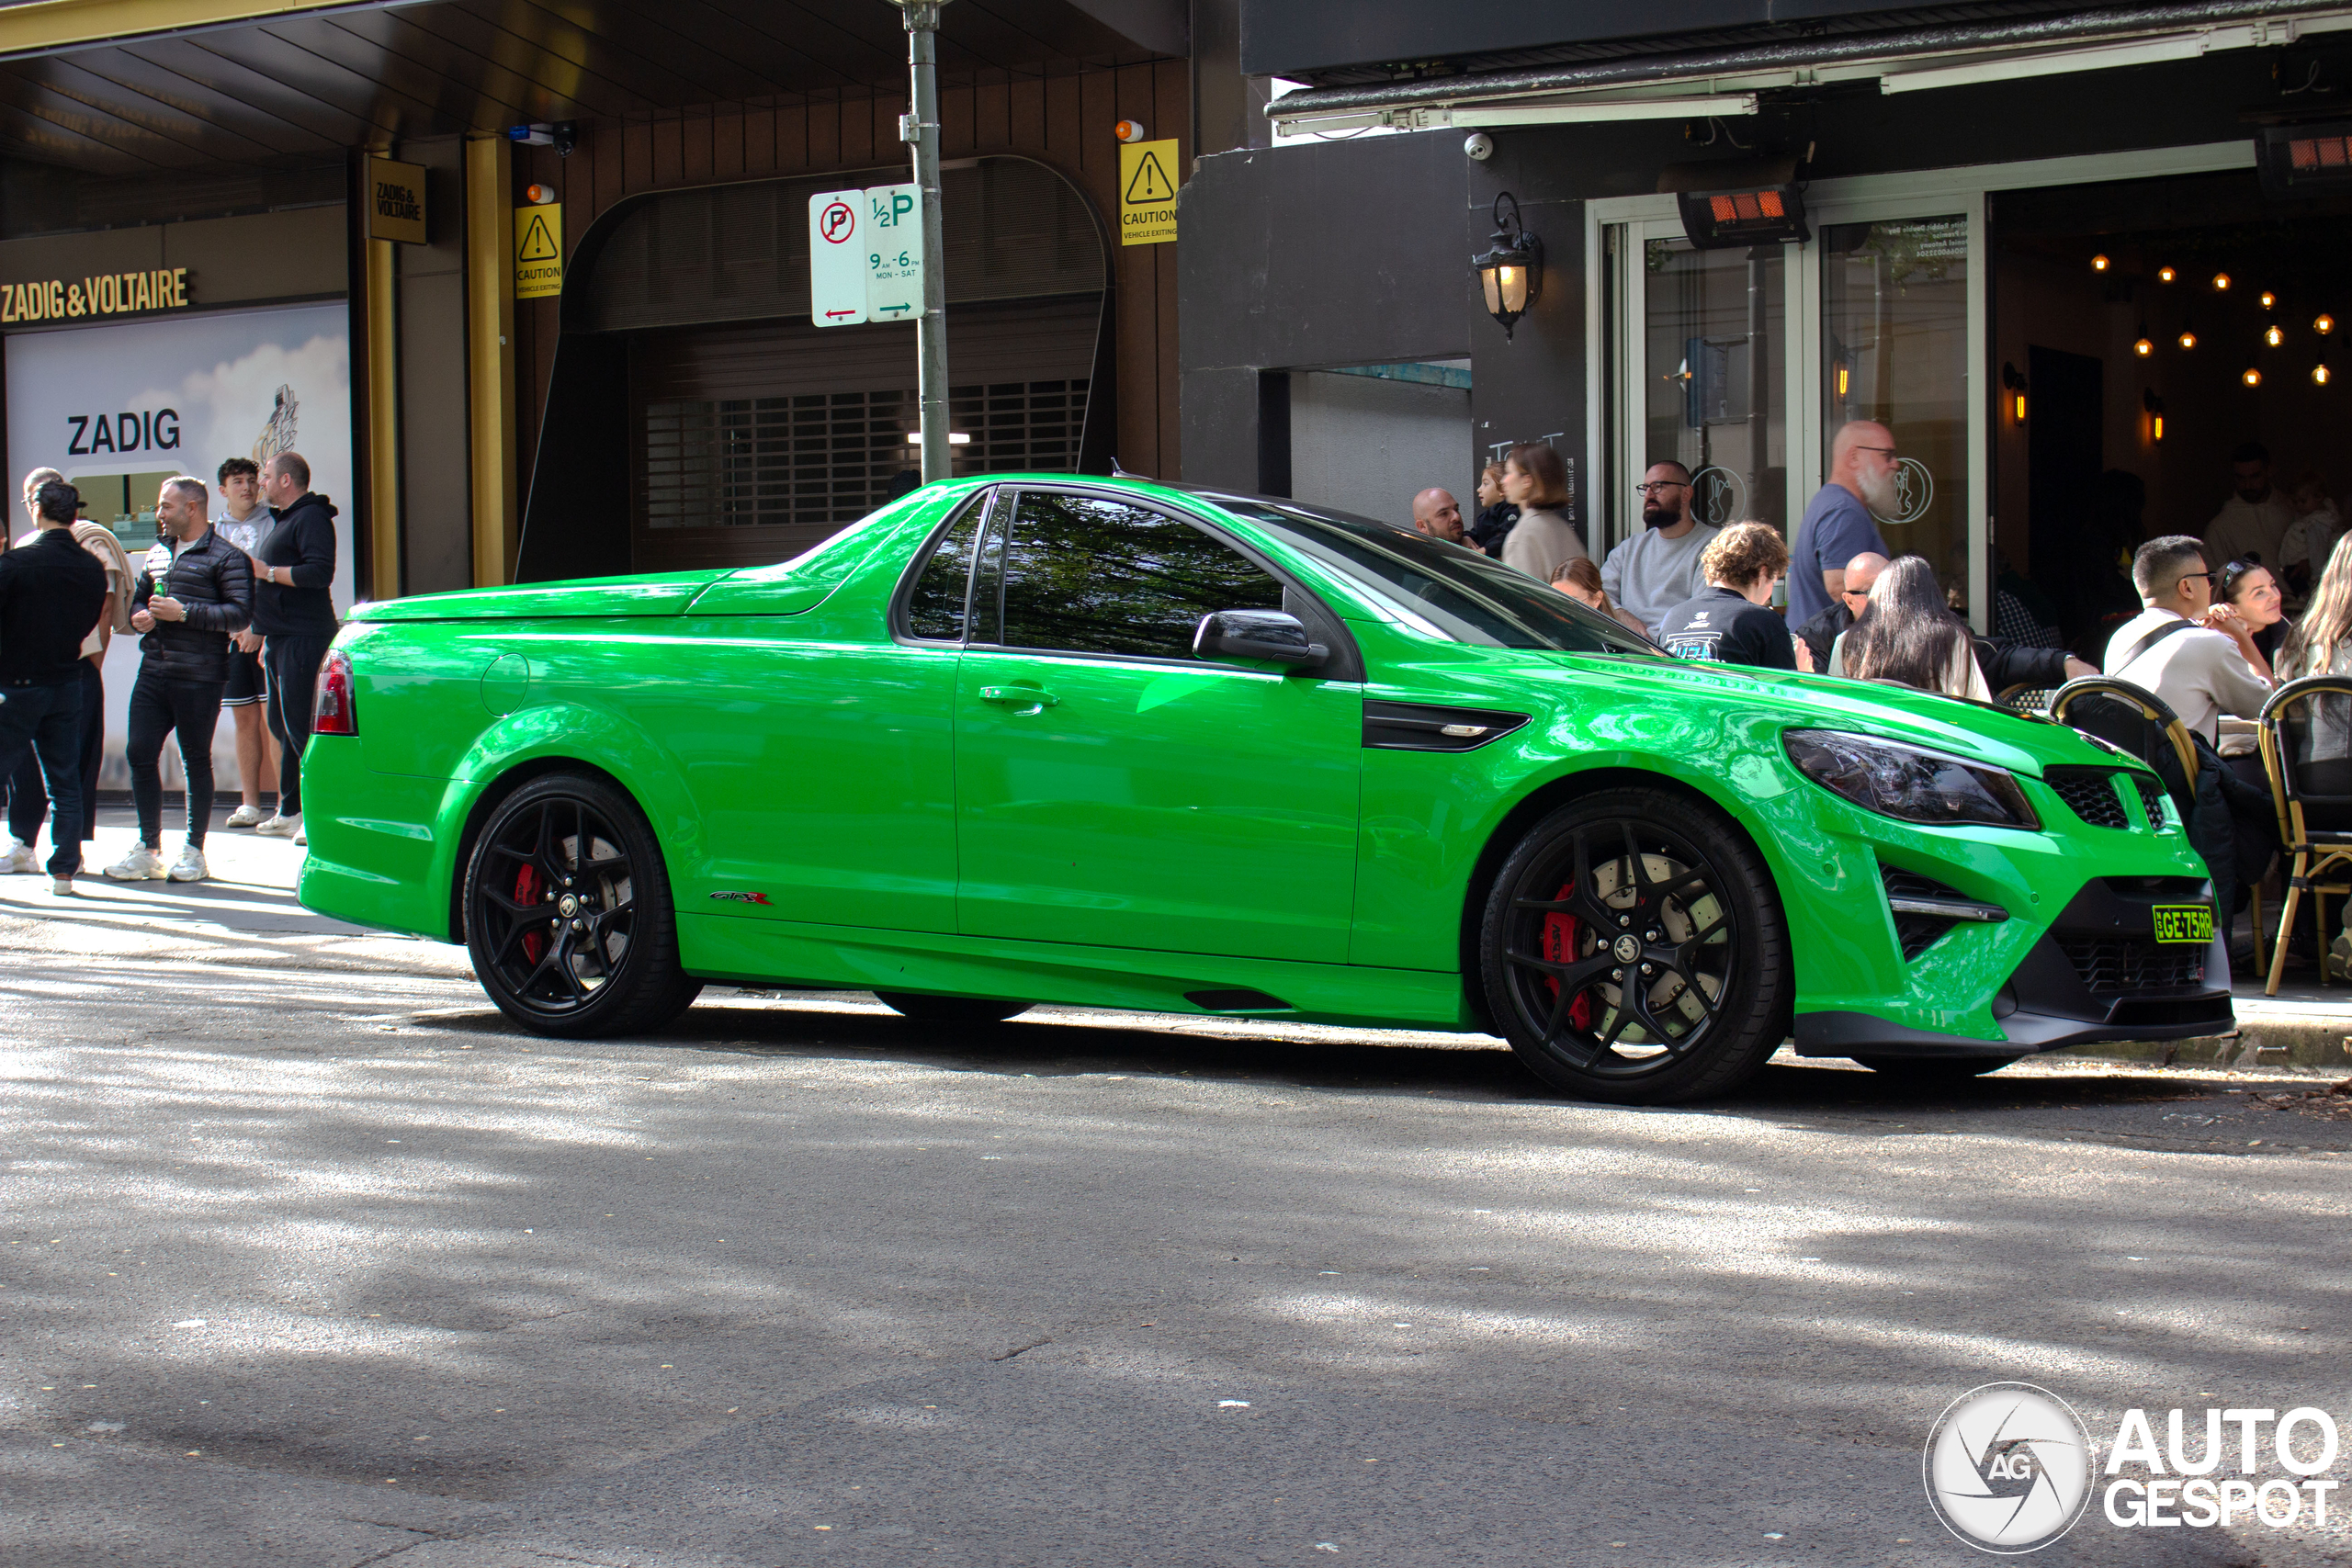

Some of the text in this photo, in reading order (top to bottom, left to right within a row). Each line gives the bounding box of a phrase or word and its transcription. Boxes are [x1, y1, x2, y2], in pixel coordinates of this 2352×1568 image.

[377, 182, 405, 201] ZADIG
[377, 198, 421, 221] VOLTAIRE
[1123, 209, 1177, 225] CAUTION
[1124, 228, 1177, 239] VEHICLE EXITING
[517, 267, 560, 280] CAUTION
[876, 271, 892, 279] MON
[901, 269, 916, 277] SAT
[68, 408, 180, 456] ZADIG
